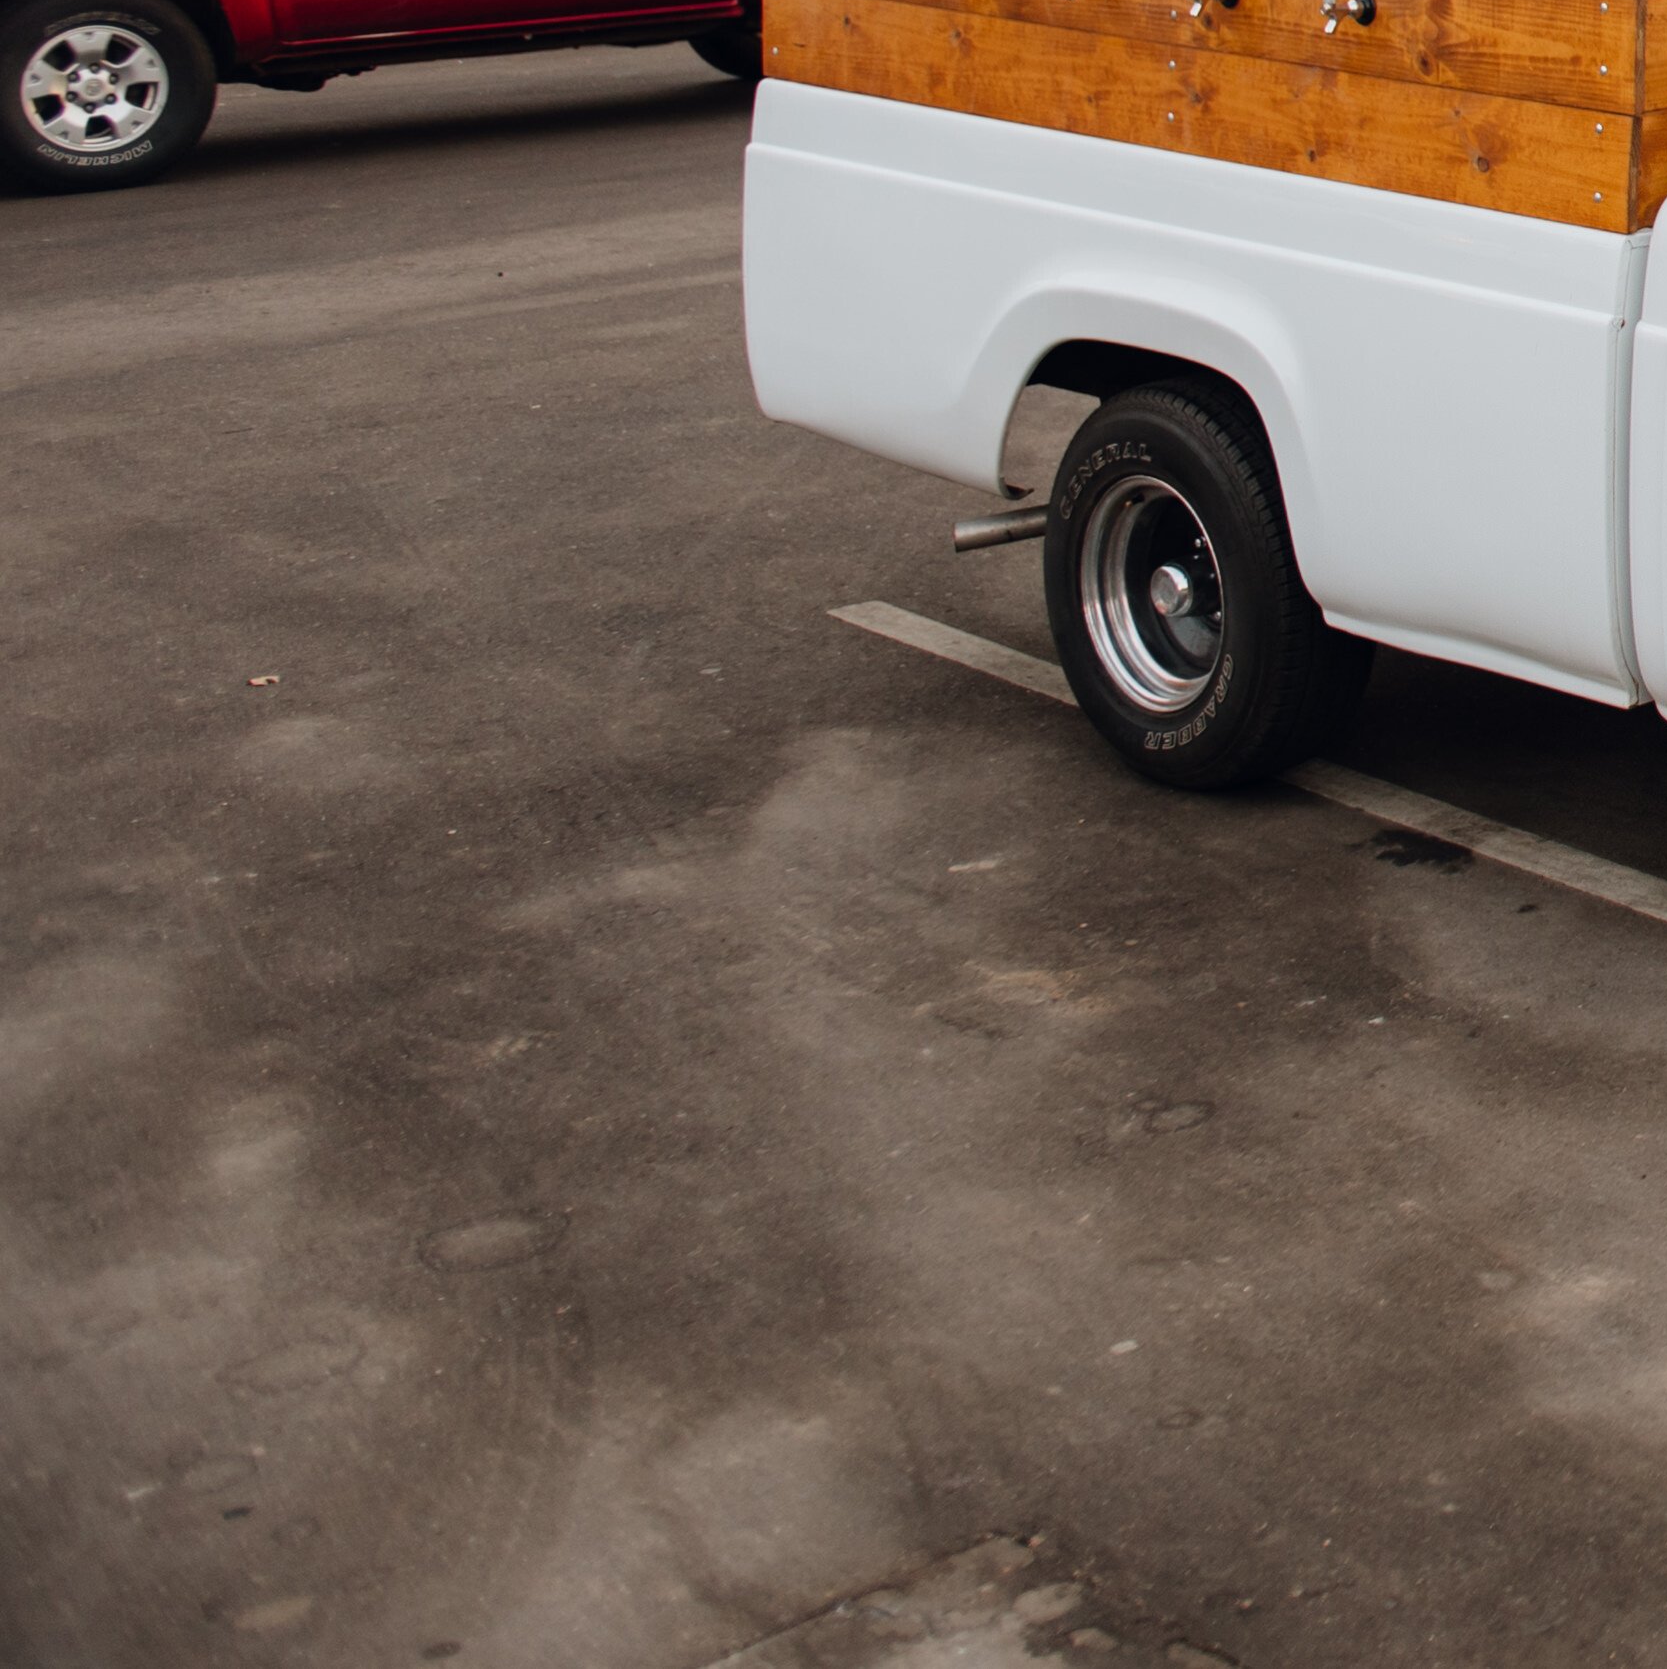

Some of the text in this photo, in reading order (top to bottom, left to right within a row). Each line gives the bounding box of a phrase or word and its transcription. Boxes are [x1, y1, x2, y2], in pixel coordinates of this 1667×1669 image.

[37, 139, 154, 166] MICHELIN
[1059, 440, 1154, 521] GENERAL
[1143, 653, 1234, 750] GRABBER
